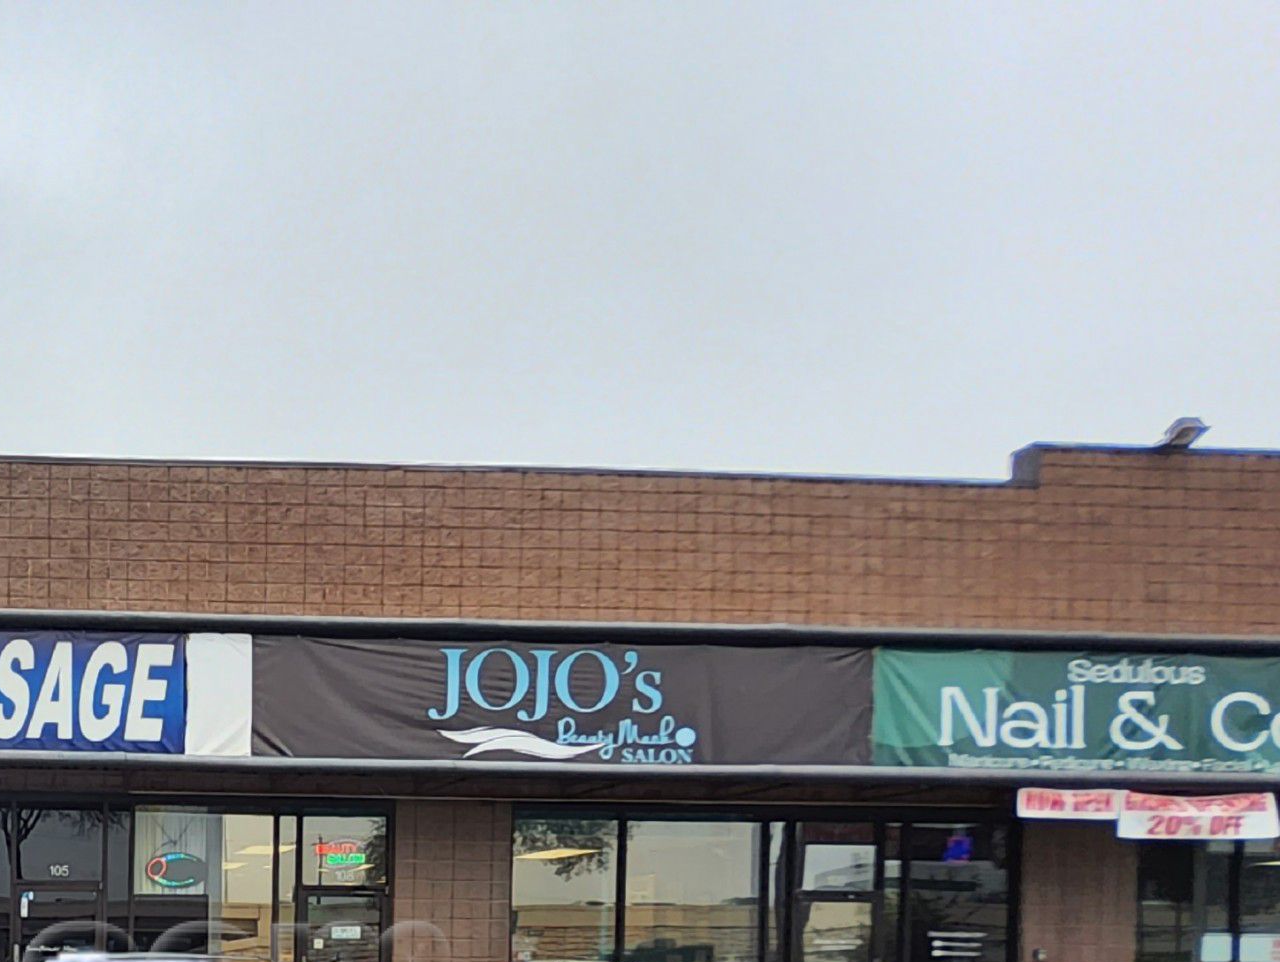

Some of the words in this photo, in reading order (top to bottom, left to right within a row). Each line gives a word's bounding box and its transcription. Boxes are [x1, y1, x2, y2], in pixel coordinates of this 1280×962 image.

[427, 648, 663, 721] JOJO's
[1067, 659, 1206, 685] Sedulous
[938, 685, 1087, 750] Nail
[1110, 690, 1184, 750] &
[1210, 691, 1280, 752] C
[621, 749, 693, 763] SALON
[49, 864, 69, 877] 105
